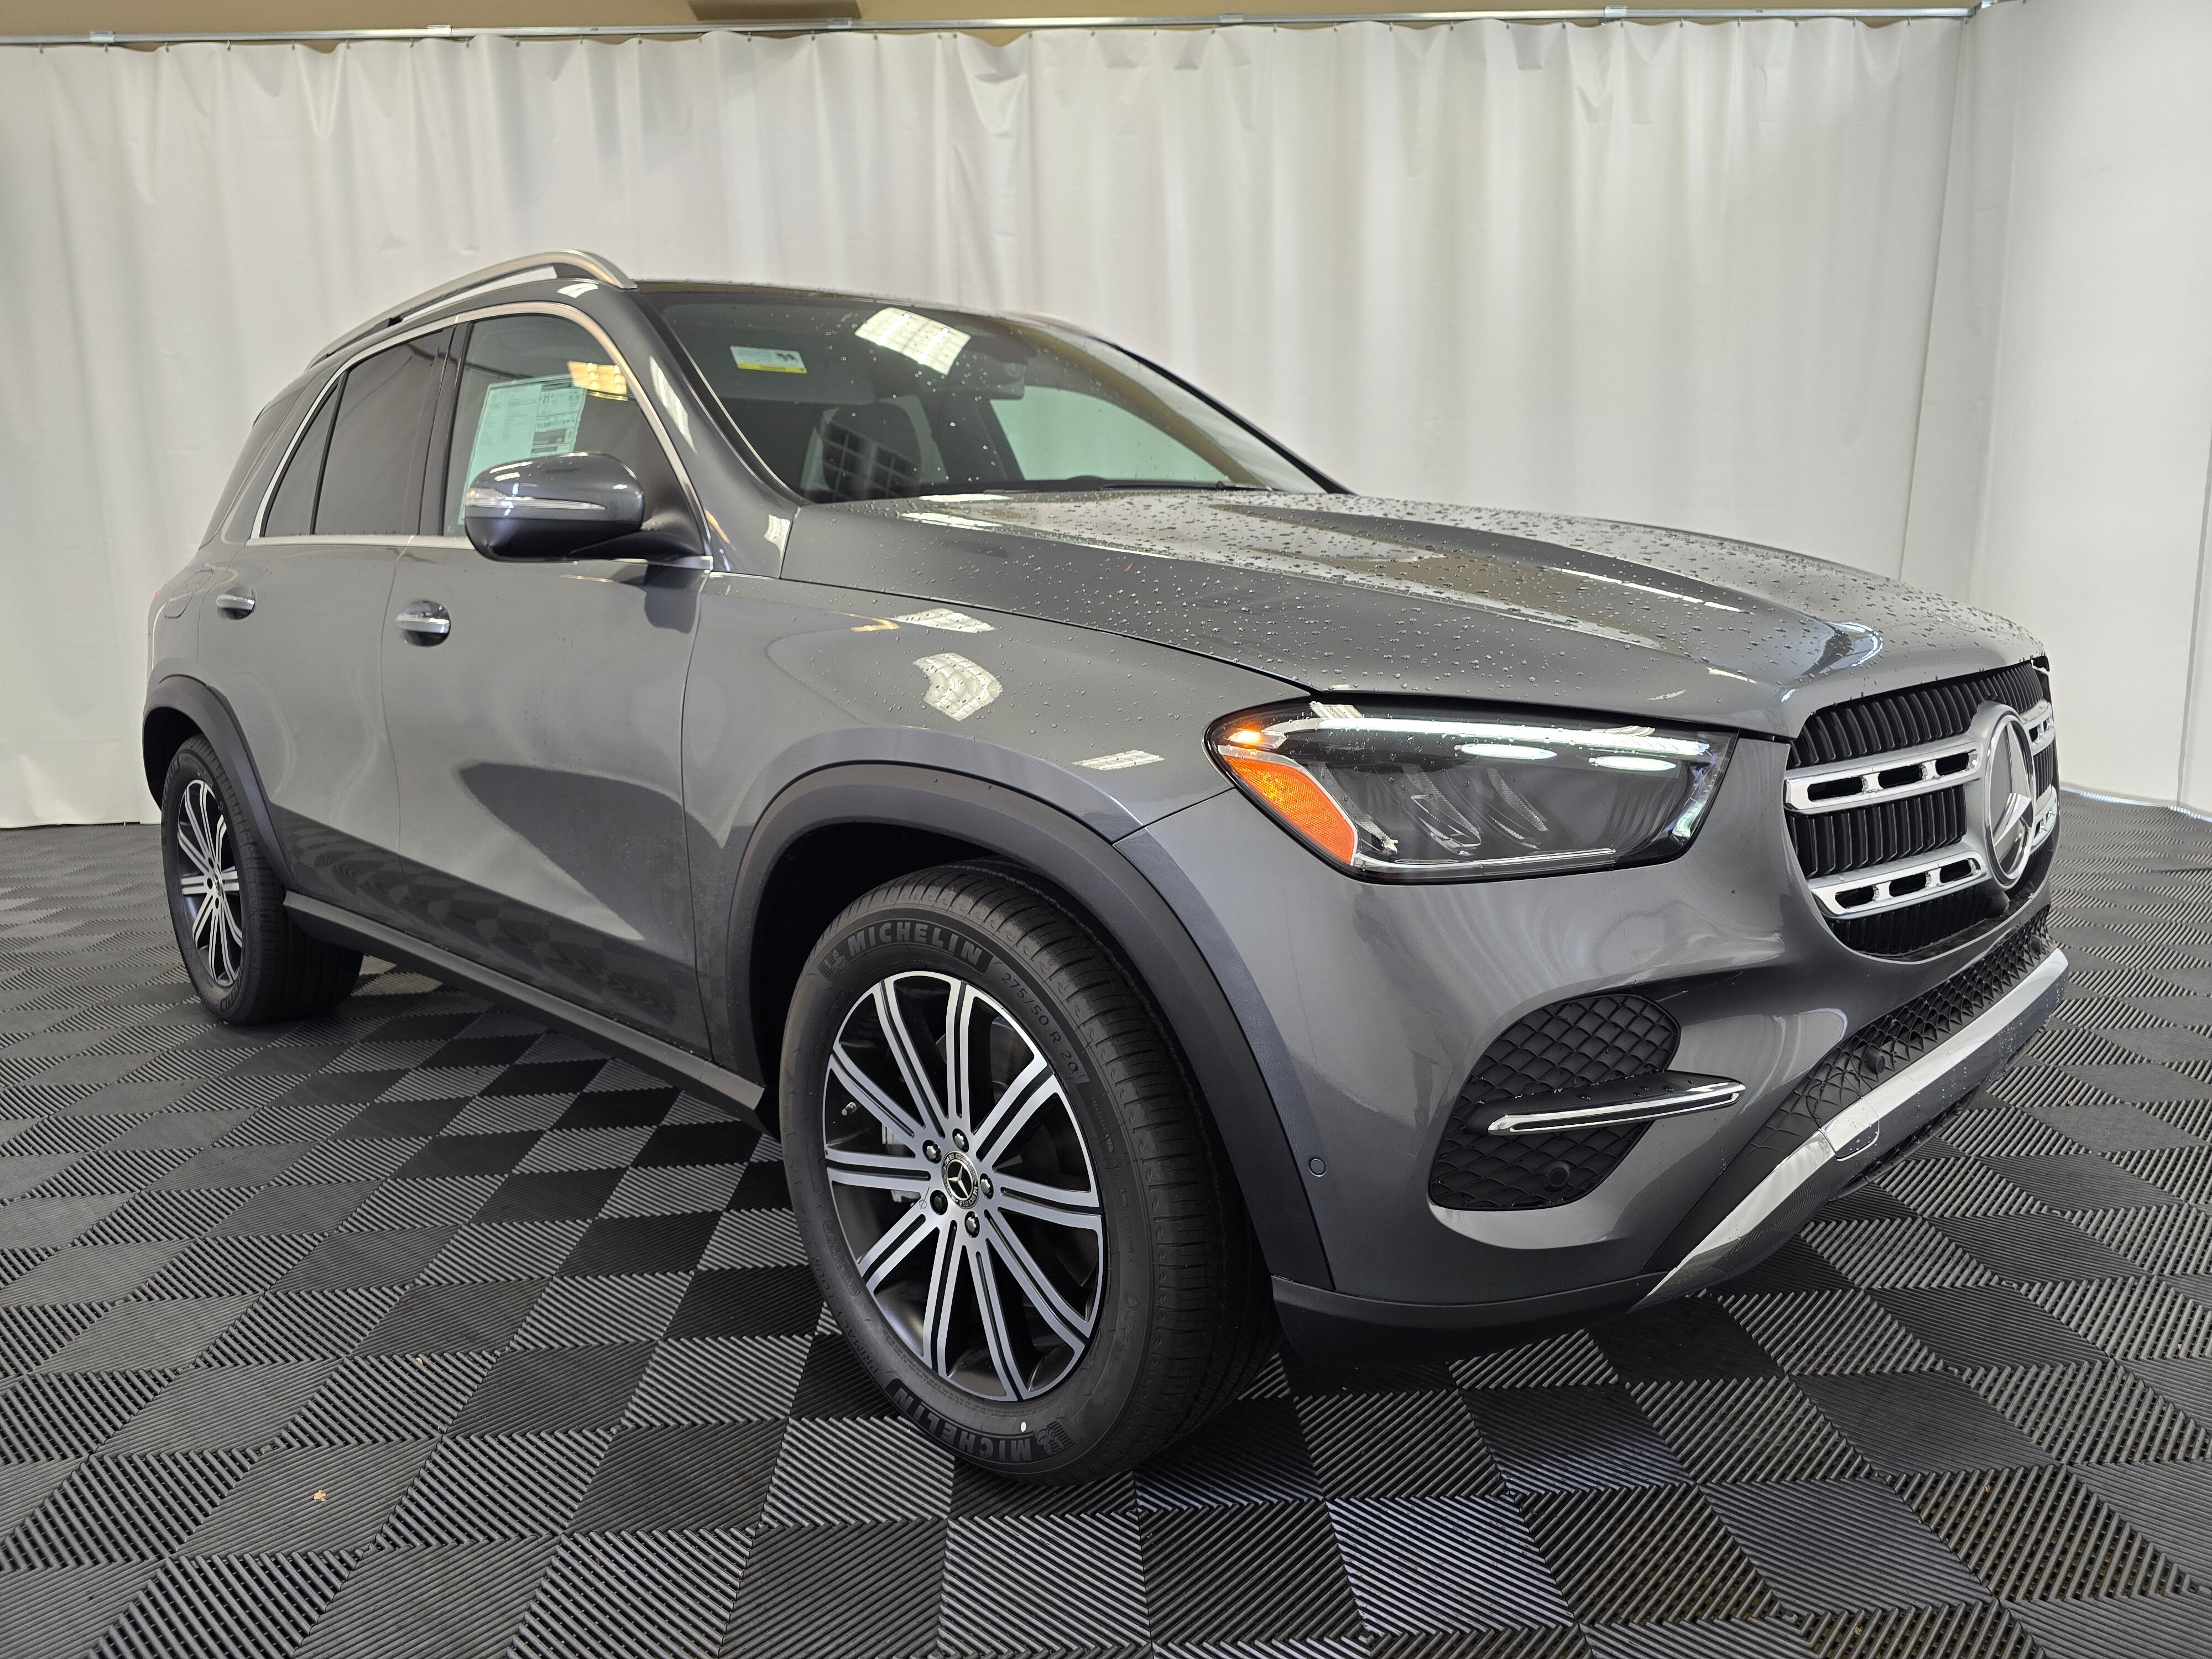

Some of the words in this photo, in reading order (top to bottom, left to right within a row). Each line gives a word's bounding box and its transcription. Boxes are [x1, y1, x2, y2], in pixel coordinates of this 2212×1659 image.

[848, 921, 982, 966] MICHELIN
[1001, 973, 1050, 1025] 275/50
[1049, 1030, 1061, 1044] R
[1060, 1050, 1079, 1072] 20
[837, 1311, 879, 1374] PRIMACY
[893, 1387, 1032, 1462] MICHELIN
